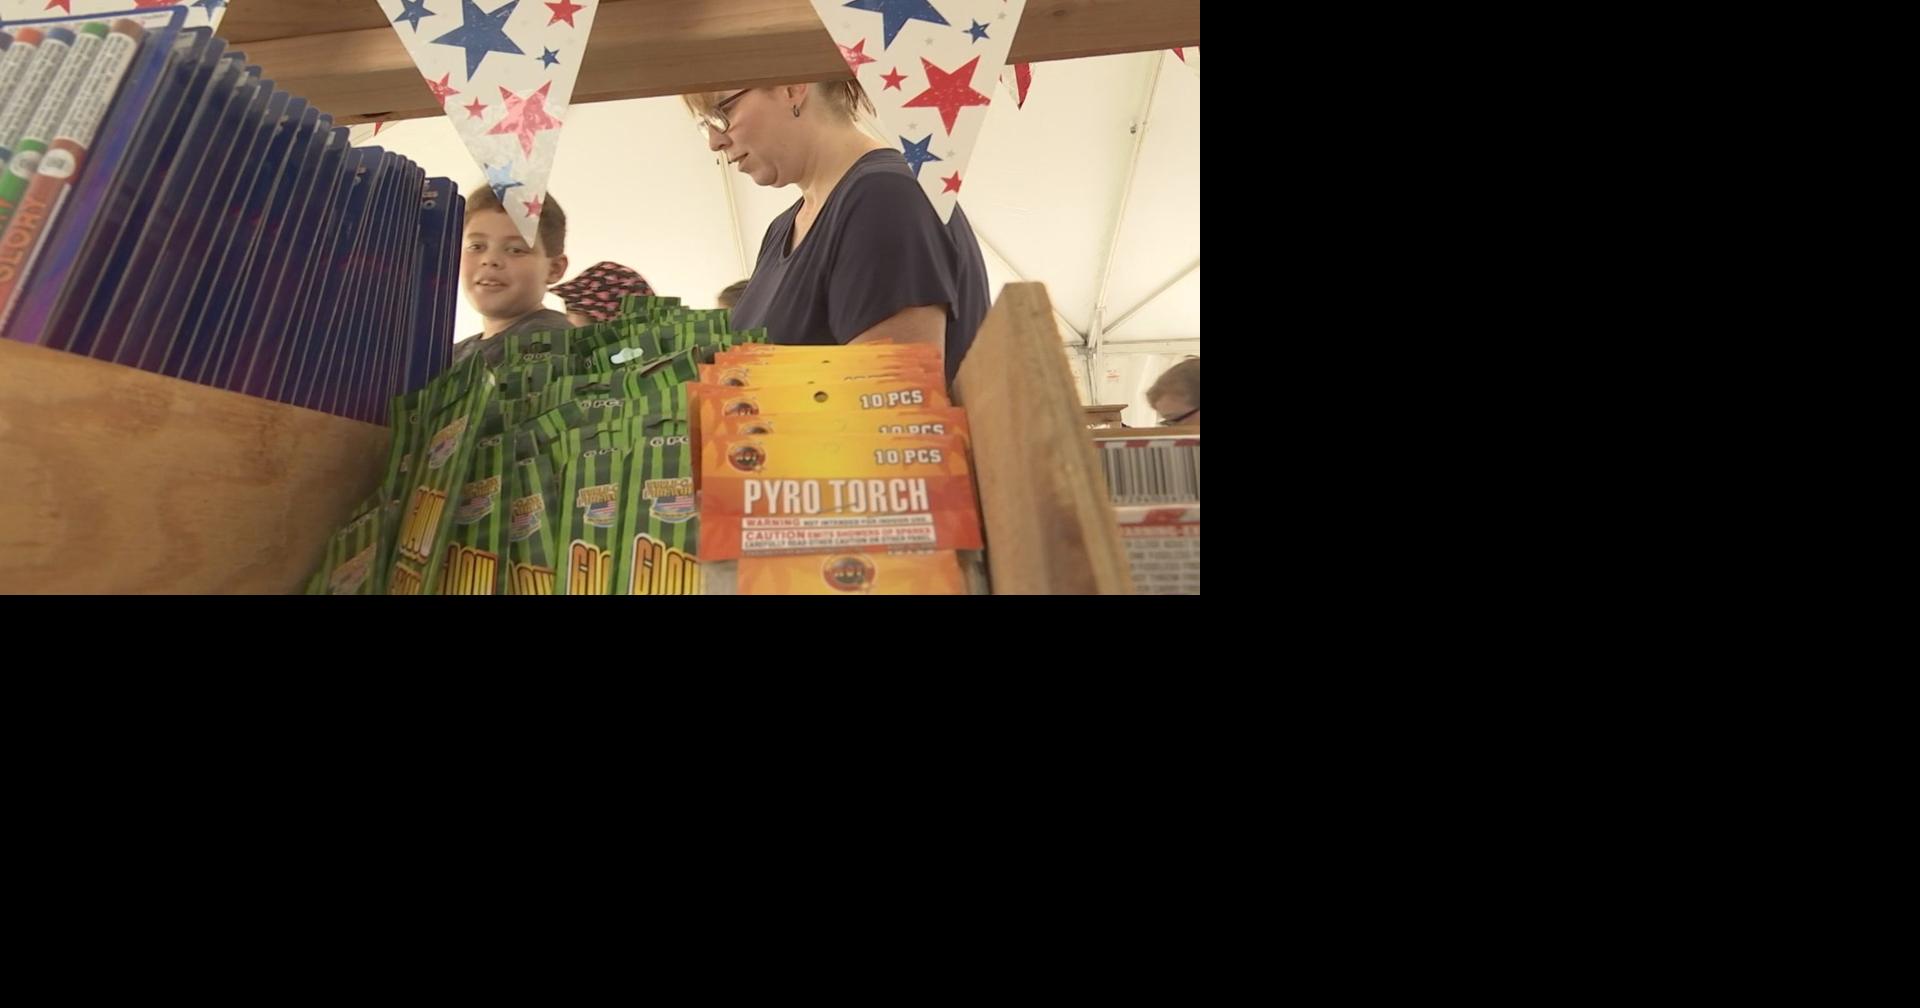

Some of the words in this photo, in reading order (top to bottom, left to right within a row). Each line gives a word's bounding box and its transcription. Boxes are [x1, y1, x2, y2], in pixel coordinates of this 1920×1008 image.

[860, 393, 883, 409] 10
[887, 389, 923, 407] PCS
[875, 450, 899, 465] 10
[903, 449, 942, 465] PCS
[743, 479, 821, 514] PYRO
[828, 478, 930, 514] TORCH
[746, 519, 800, 527] WARNING
[746, 530, 805, 540] CAUTION
